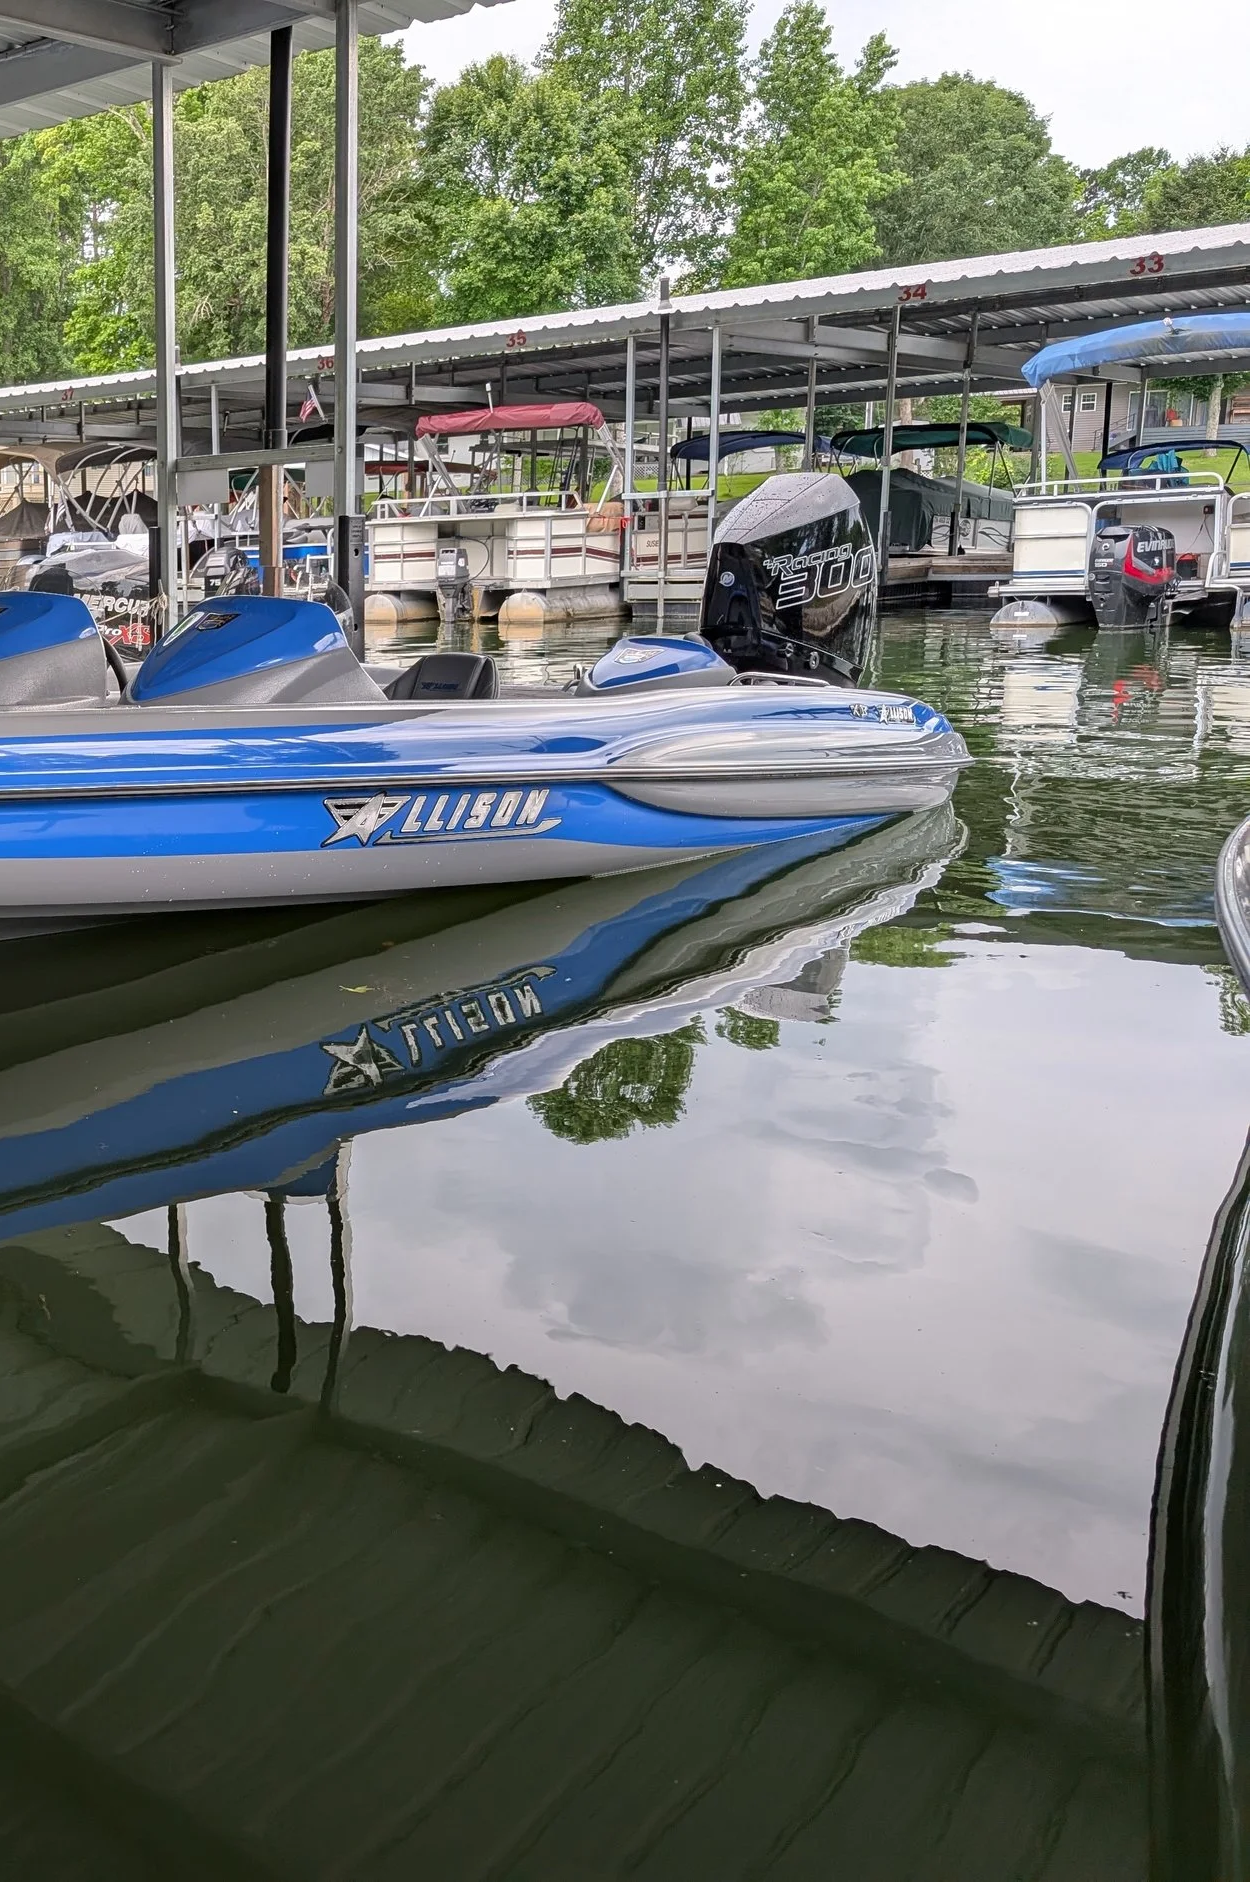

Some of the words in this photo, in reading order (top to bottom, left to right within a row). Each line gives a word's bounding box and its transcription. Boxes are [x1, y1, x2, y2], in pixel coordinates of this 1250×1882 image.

[1130, 254, 1164, 275] 33
[898, 283, 927, 302] 34
[506, 331, 526, 348] 35
[317, 356, 334, 371] 36
[61, 388, 74, 402] 37
[775, 545, 875, 610] 300
[73, 594, 150, 618] MERCUR
[321, 790, 553, 848] ALLISON
